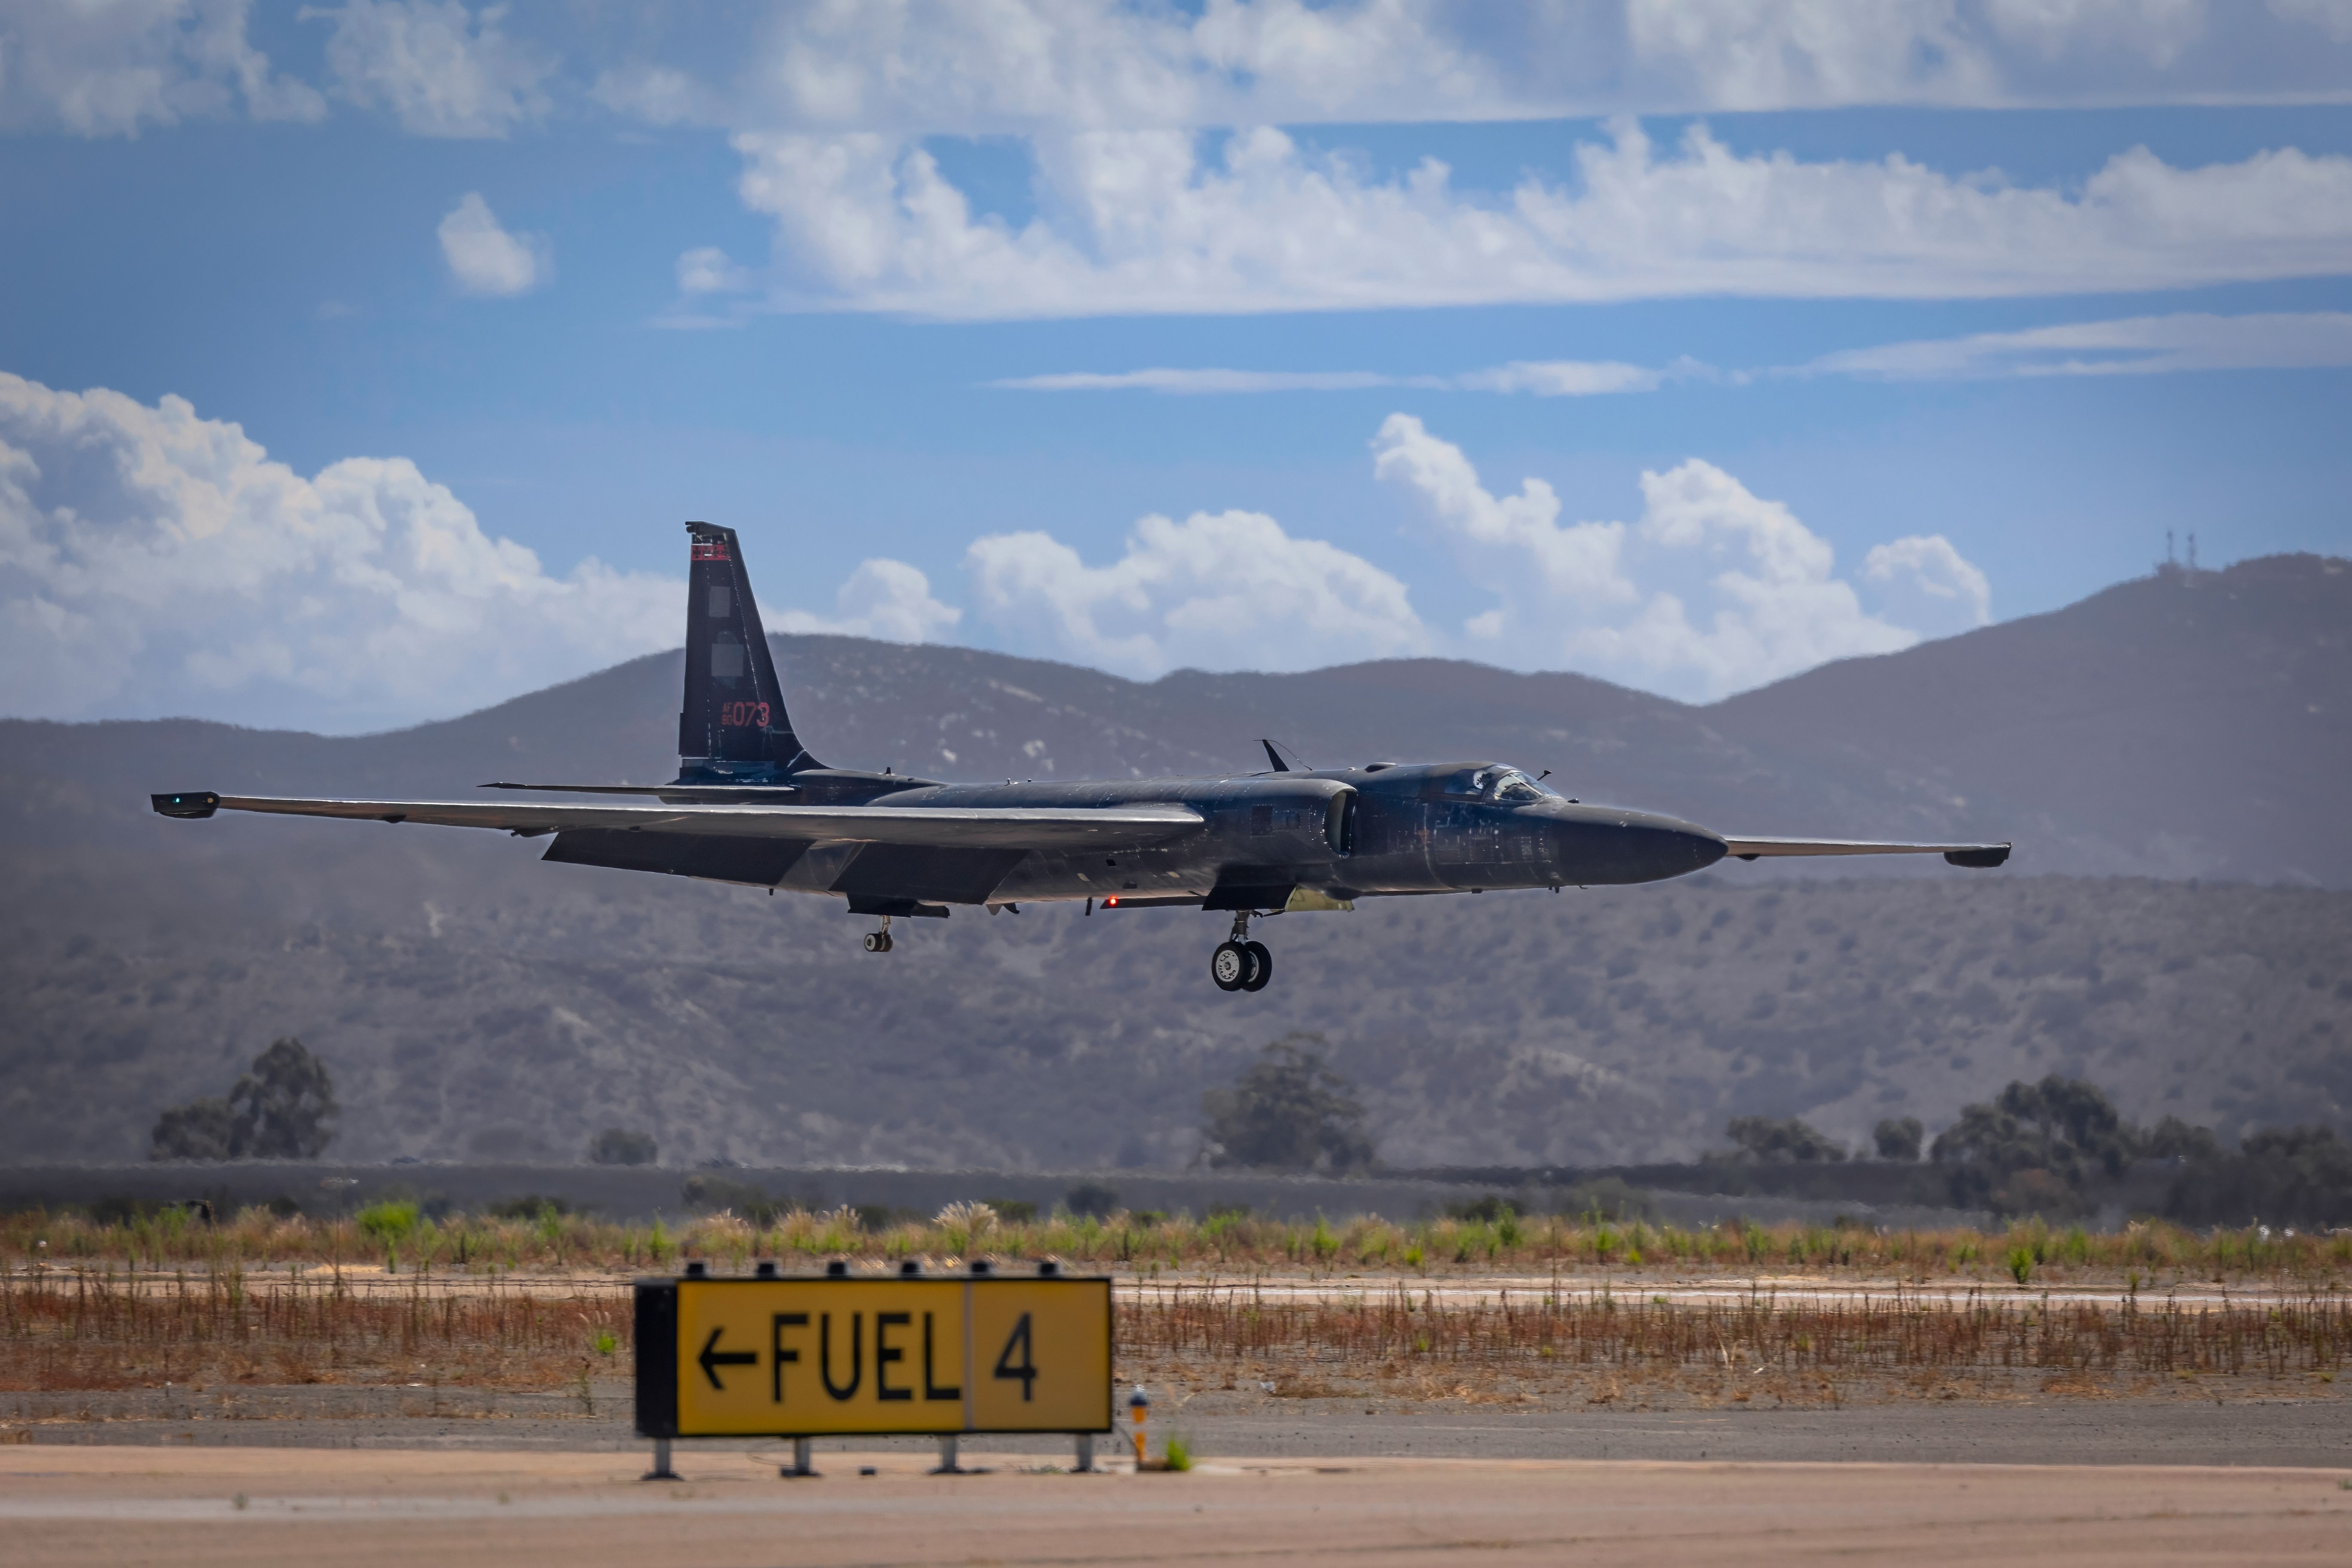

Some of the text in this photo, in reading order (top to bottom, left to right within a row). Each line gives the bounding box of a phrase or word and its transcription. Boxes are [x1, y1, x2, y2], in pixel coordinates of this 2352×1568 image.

[733, 701, 770, 727] 073
[771, 1311, 1038, 1404] FUEL 4
